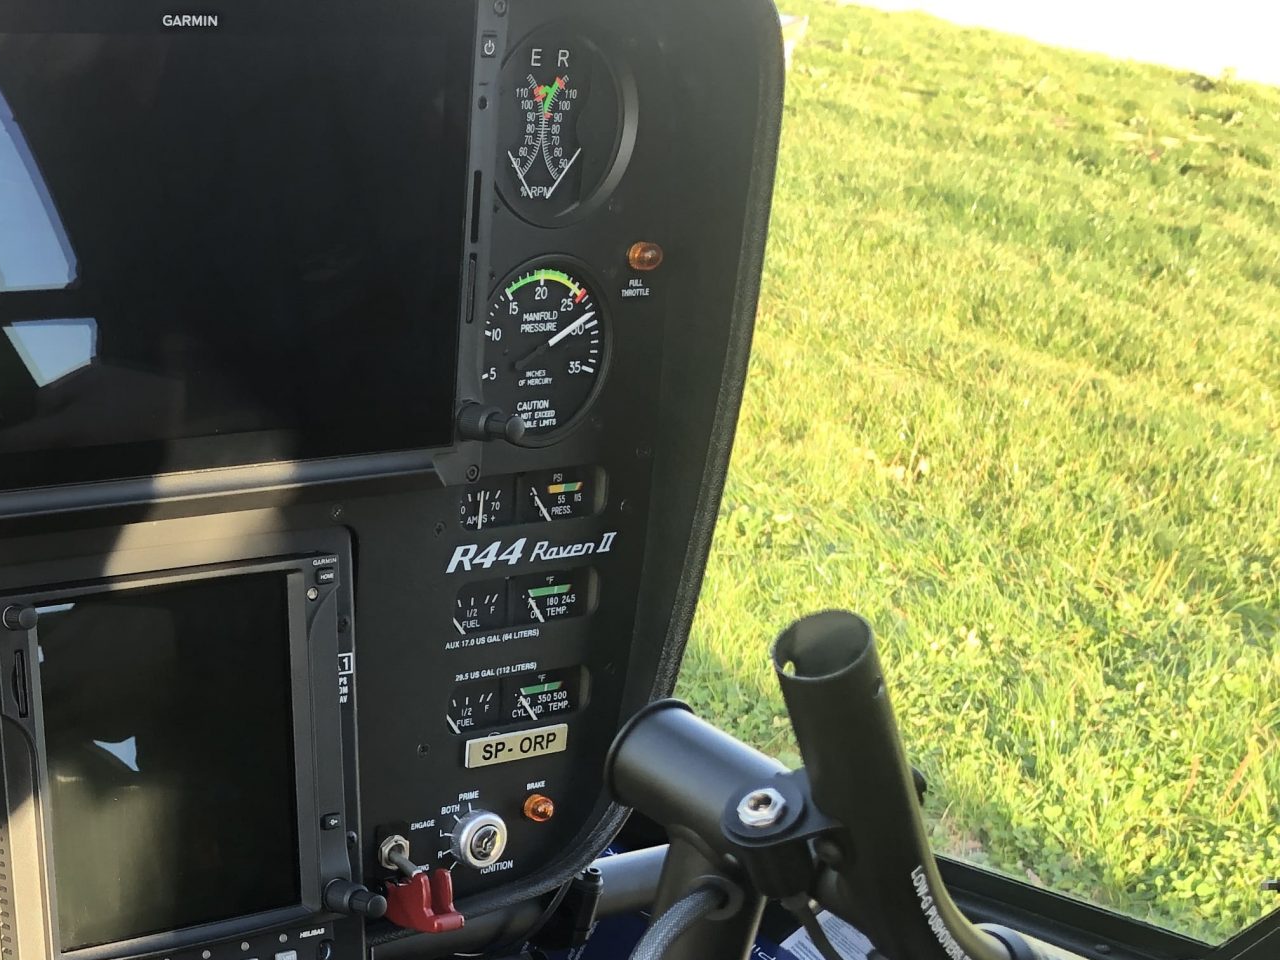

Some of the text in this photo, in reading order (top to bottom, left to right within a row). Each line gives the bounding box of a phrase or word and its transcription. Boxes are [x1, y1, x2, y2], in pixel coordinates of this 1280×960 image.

[162, 15, 218, 27] GARMIN
[531, 49, 570, 68] E R
[516, 88, 528, 98] 110
[565, 89, 578, 99] 110
[521, 100, 534, 110] 100
[558, 101, 570, 111] 100
[526, 112, 536, 122] 90
[553, 113, 563, 123] 90
[526, 124, 535, 134] 80
[551, 124, 561, 134] 80
[629, 279, 643, 287] FULL
[534, 287, 548, 300] 20
[621, 288, 650, 297] THROTTLE
[508, 302, 519, 315] 15
[560, 299, 574, 312] 25
[522, 311, 558, 321] MANIFOLD
[520, 322, 557, 333] PRESSURE
[491, 328, 502, 341] 10
[568, 361, 581, 374] 35
[489, 367, 497, 380] 5
[525, 370, 546, 378] INCHES
[518, 377, 553, 387] OF MERCURY
[516, 400, 550, 411] CAUTION
[491, 502, 501, 511] 70
[445, 531, 617, 574] R44 Raven II
[312, 557, 337, 566] GARMIN
[462, 619, 480, 629] FUEL
[445, 641, 460, 650] AUX
[462, 638, 475, 647] 17.0
[476, 636, 486, 645] US
[487, 634, 501, 643] GAL
[514, 628, 540, 640] LITERS)
[455, 673, 469, 682] 29.5
[470, 671, 480, 680] US
[481, 668, 495, 678] GAL
[511, 661, 537, 673] LITERS)
[537, 690, 567, 704] 350 500
[456, 717, 475, 727] FUEL
[519, 732, 557, 754] ORP
[526, 780, 545, 790] BRAKE
[458, 790, 479, 801] PRIME
[441, 804, 460, 815] BOTH
[410, 819, 435, 830] ENGAGE
[911, 865, 933, 910] LOW-G
